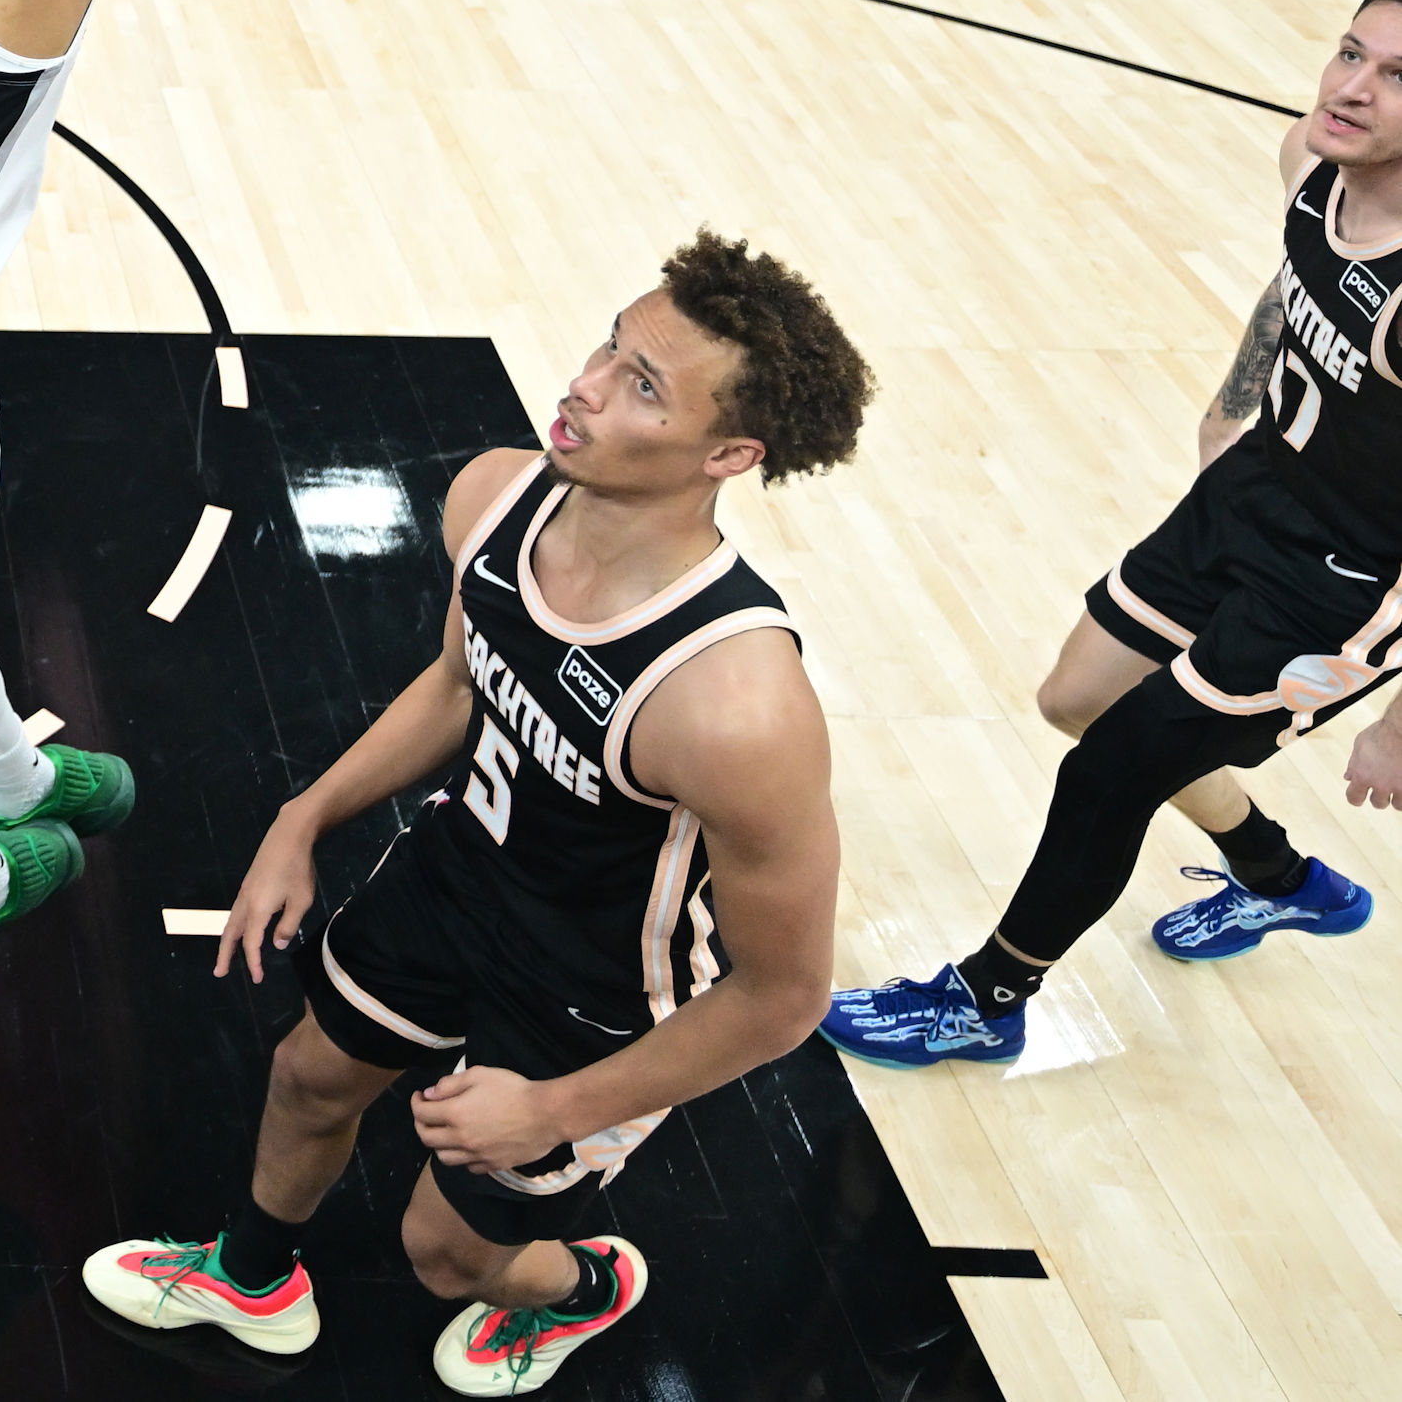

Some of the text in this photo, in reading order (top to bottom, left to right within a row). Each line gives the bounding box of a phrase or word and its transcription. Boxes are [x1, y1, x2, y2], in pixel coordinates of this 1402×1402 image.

[1345, 270, 1382, 309] paze
[565, 658, 612, 710] paze
[462, 712, 520, 846] 5
